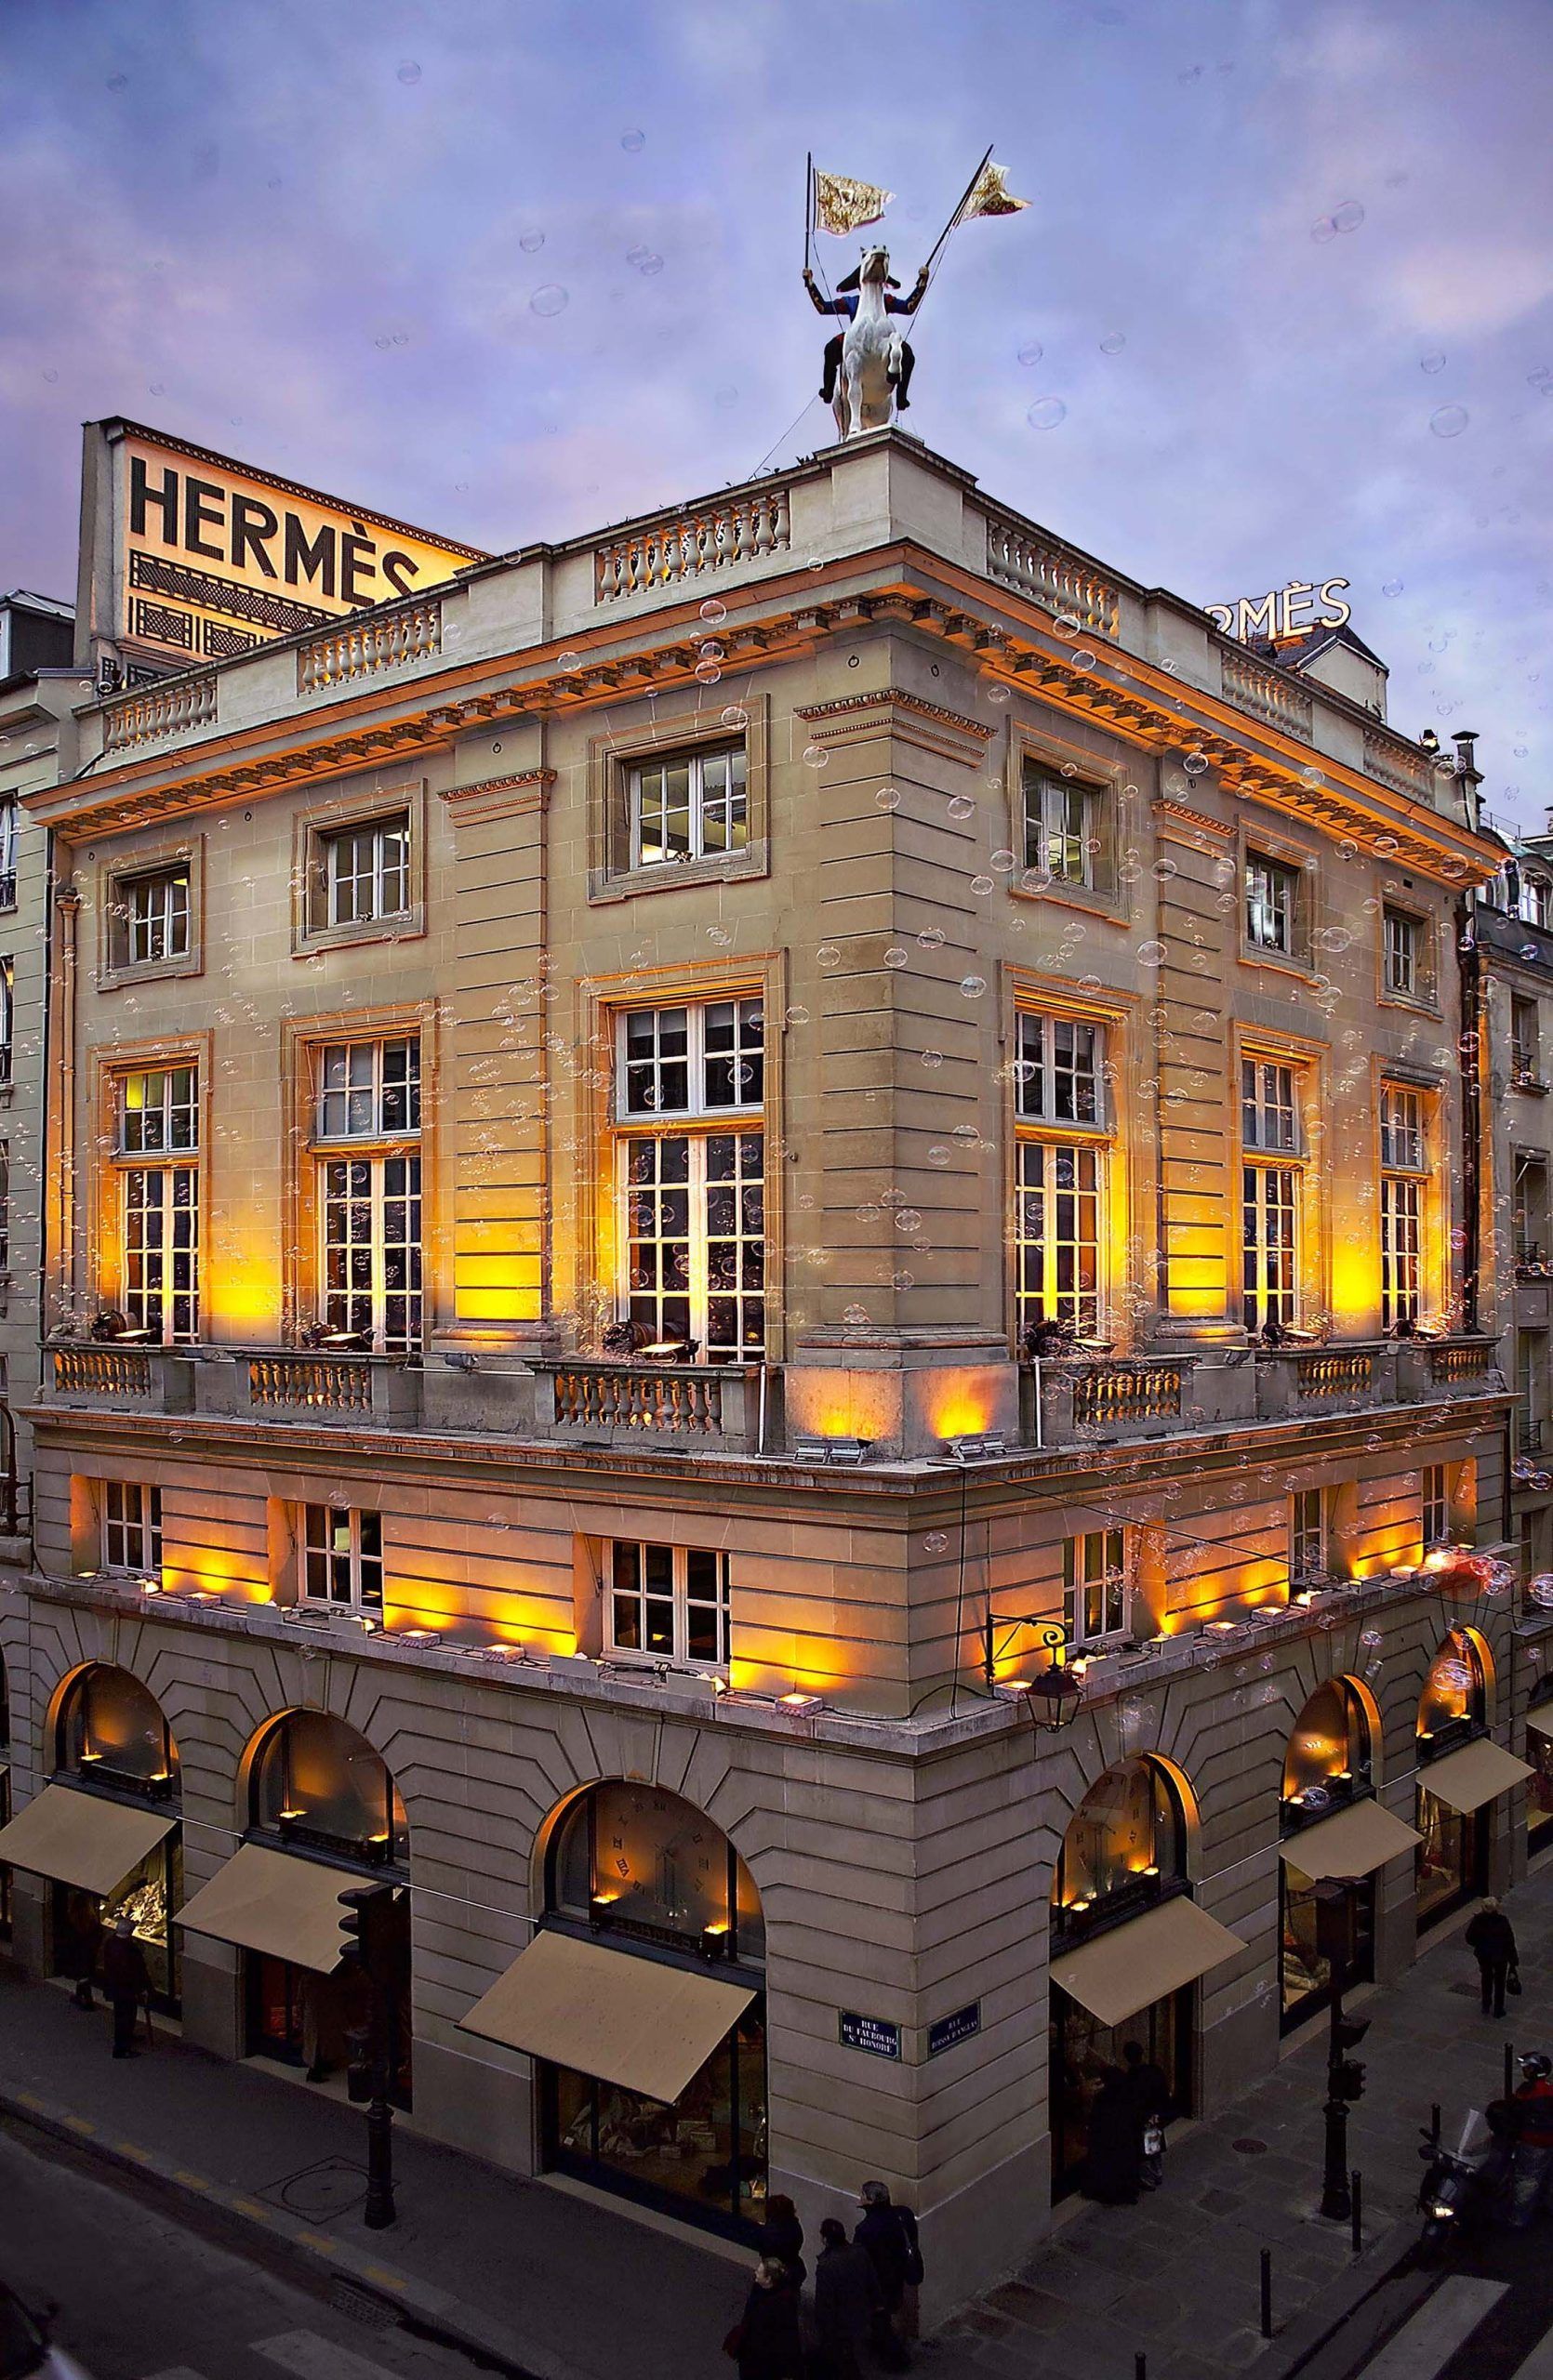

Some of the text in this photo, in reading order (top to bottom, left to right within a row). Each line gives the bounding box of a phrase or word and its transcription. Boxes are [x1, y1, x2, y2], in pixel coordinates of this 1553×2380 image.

[861, 2019, 879, 2032] RUE
[843, 2024, 897, 2045] DU FAUBOURG
